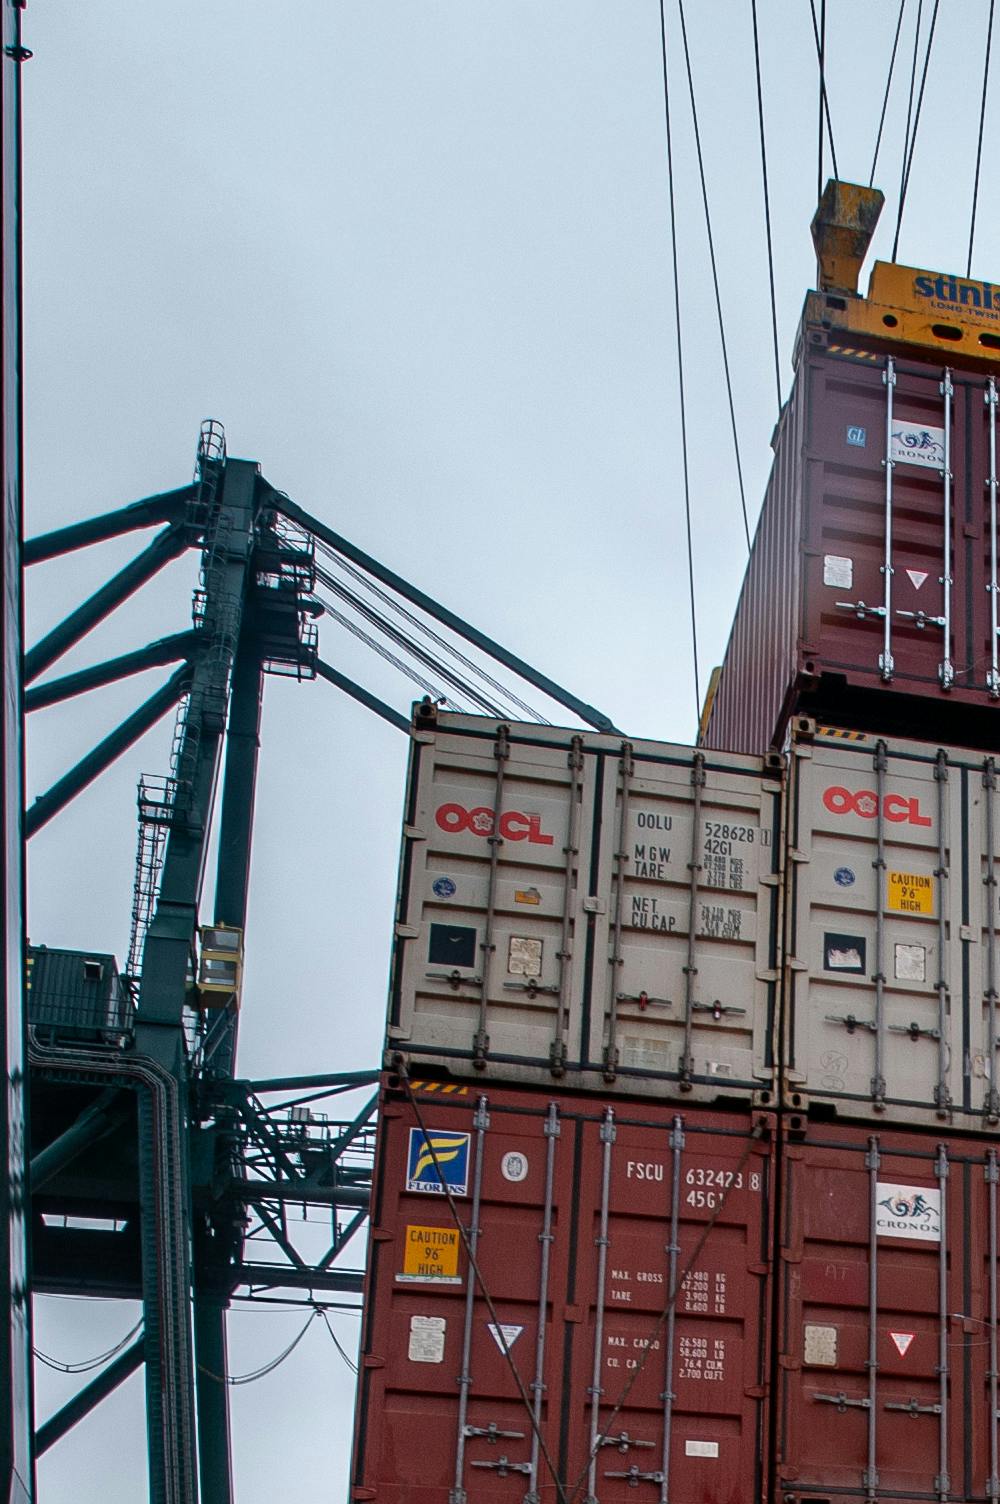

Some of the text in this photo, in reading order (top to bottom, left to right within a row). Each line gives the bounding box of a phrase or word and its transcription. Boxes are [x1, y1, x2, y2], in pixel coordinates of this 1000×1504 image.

[898, 450, 945, 463] RONOS
[638, 812, 672, 831] OOLU
[705, 822, 754, 843] 528628
[704, 839, 732, 855] 42G1
[891, 872, 930, 888] CAUTION
[900, 900, 921, 911] HIGH
[627, 1162, 664, 1181] FSCU
[877, 1219, 940, 1233] CRONOS
[410, 1230, 455, 1245] CAUTION
[418, 1263, 444, 1275] HIGH
[612, 1290, 632, 1301] TARE
[633, 1339, 660, 1349] CARO
